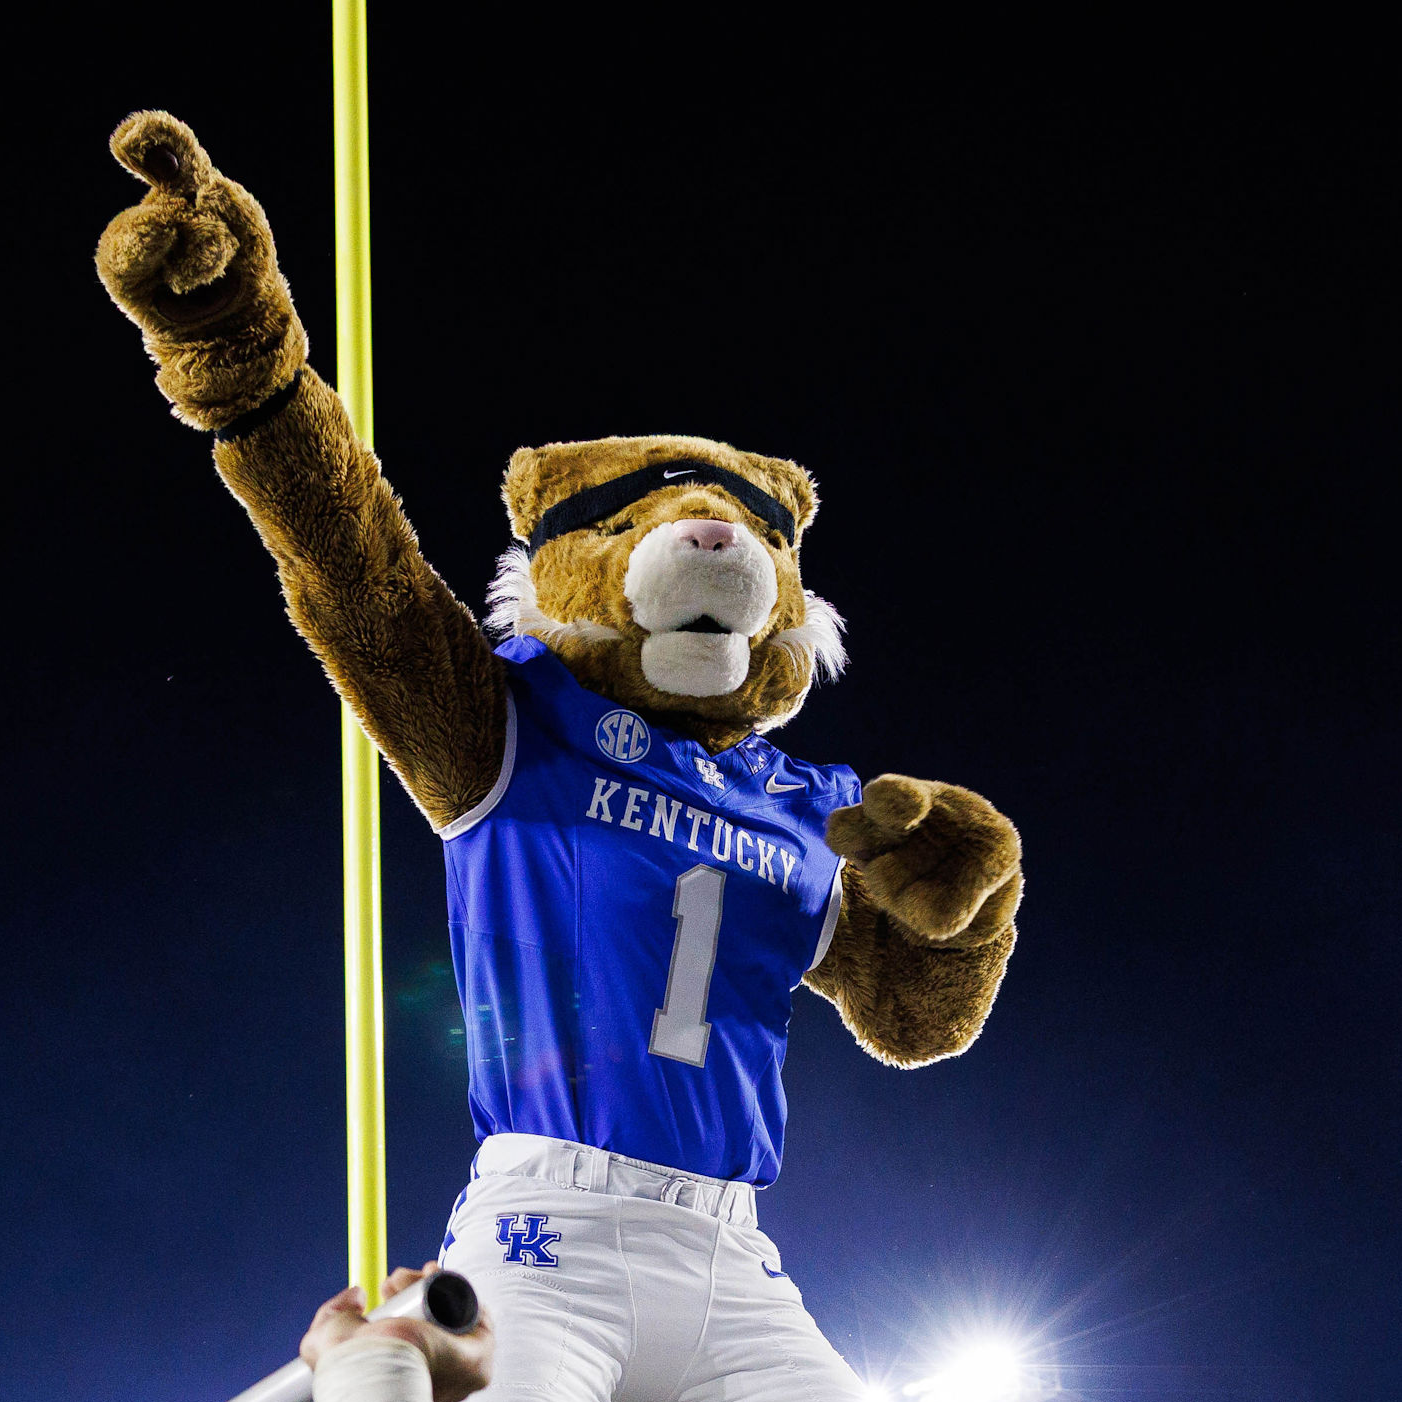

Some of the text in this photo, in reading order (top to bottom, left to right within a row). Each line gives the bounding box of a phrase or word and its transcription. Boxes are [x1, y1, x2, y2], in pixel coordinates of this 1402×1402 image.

[599, 712, 647, 760] SEC
[694, 756, 725, 791] UK
[585, 776, 796, 895] KENTUCKY
[648, 863, 727, 1068] 1
[495, 1213, 562, 1268] UK
